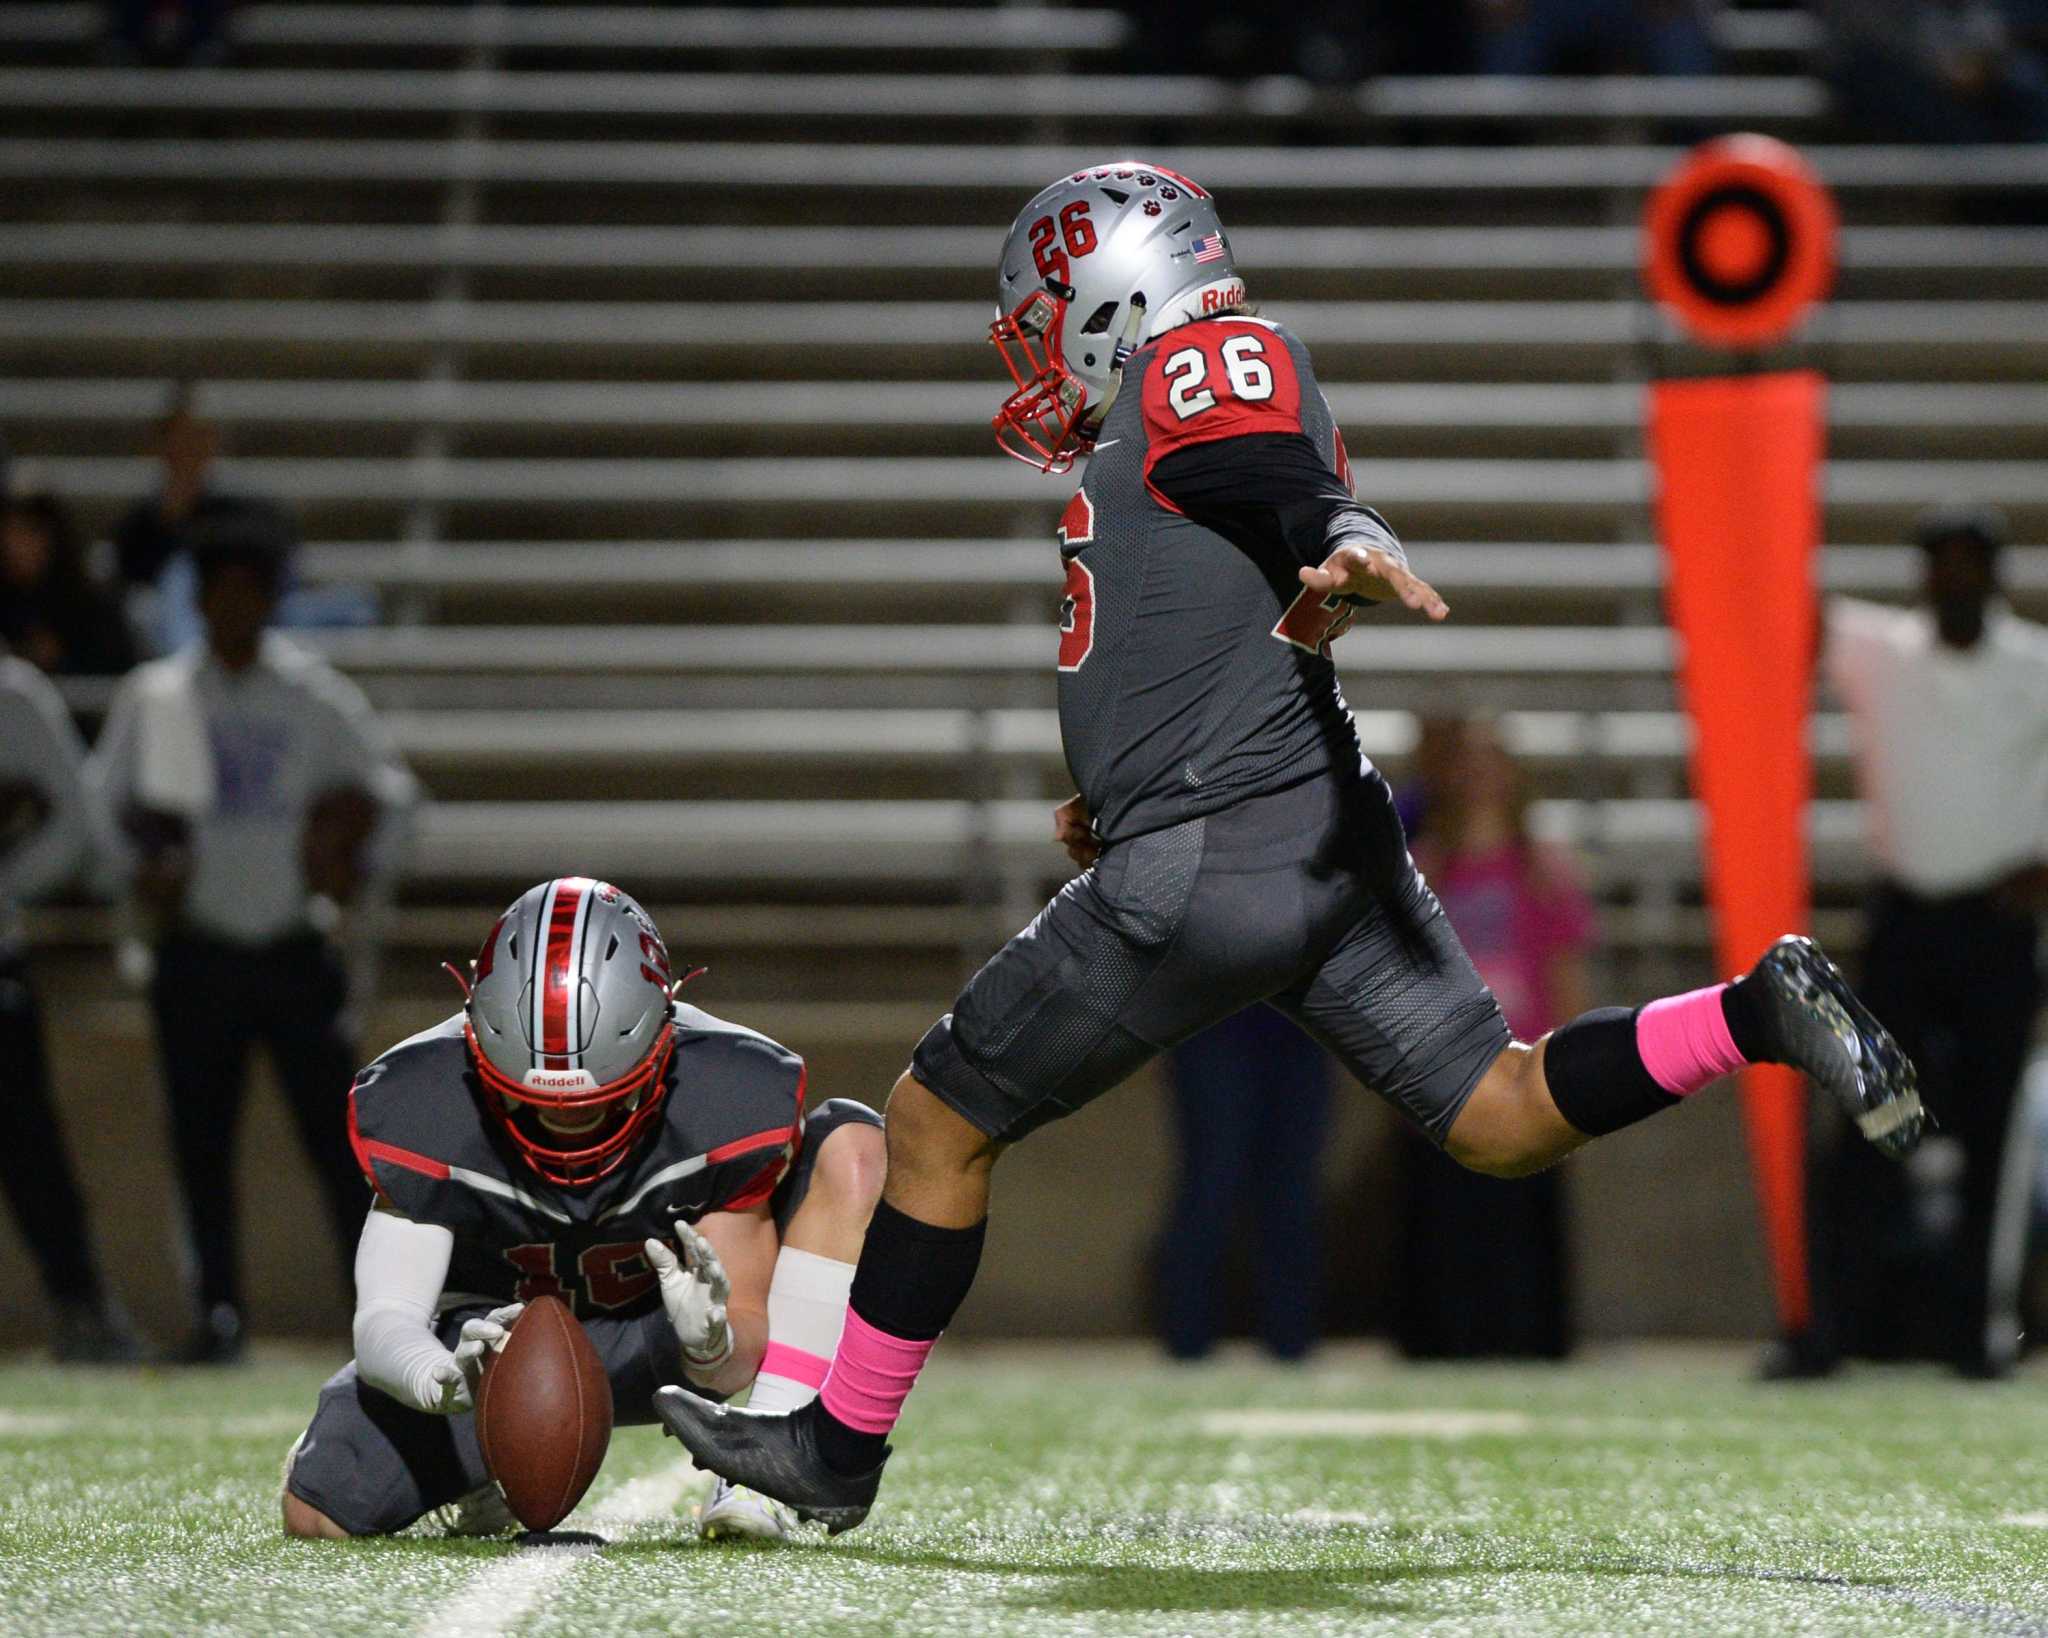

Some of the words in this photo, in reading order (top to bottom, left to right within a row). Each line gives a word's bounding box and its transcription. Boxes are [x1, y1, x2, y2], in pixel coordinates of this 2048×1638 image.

[1028, 199, 1098, 280] 26
[1201, 284, 1246, 312] Ridd
[1163, 334, 1275, 422] 26
[531, 1074, 585, 1088] Riddell
